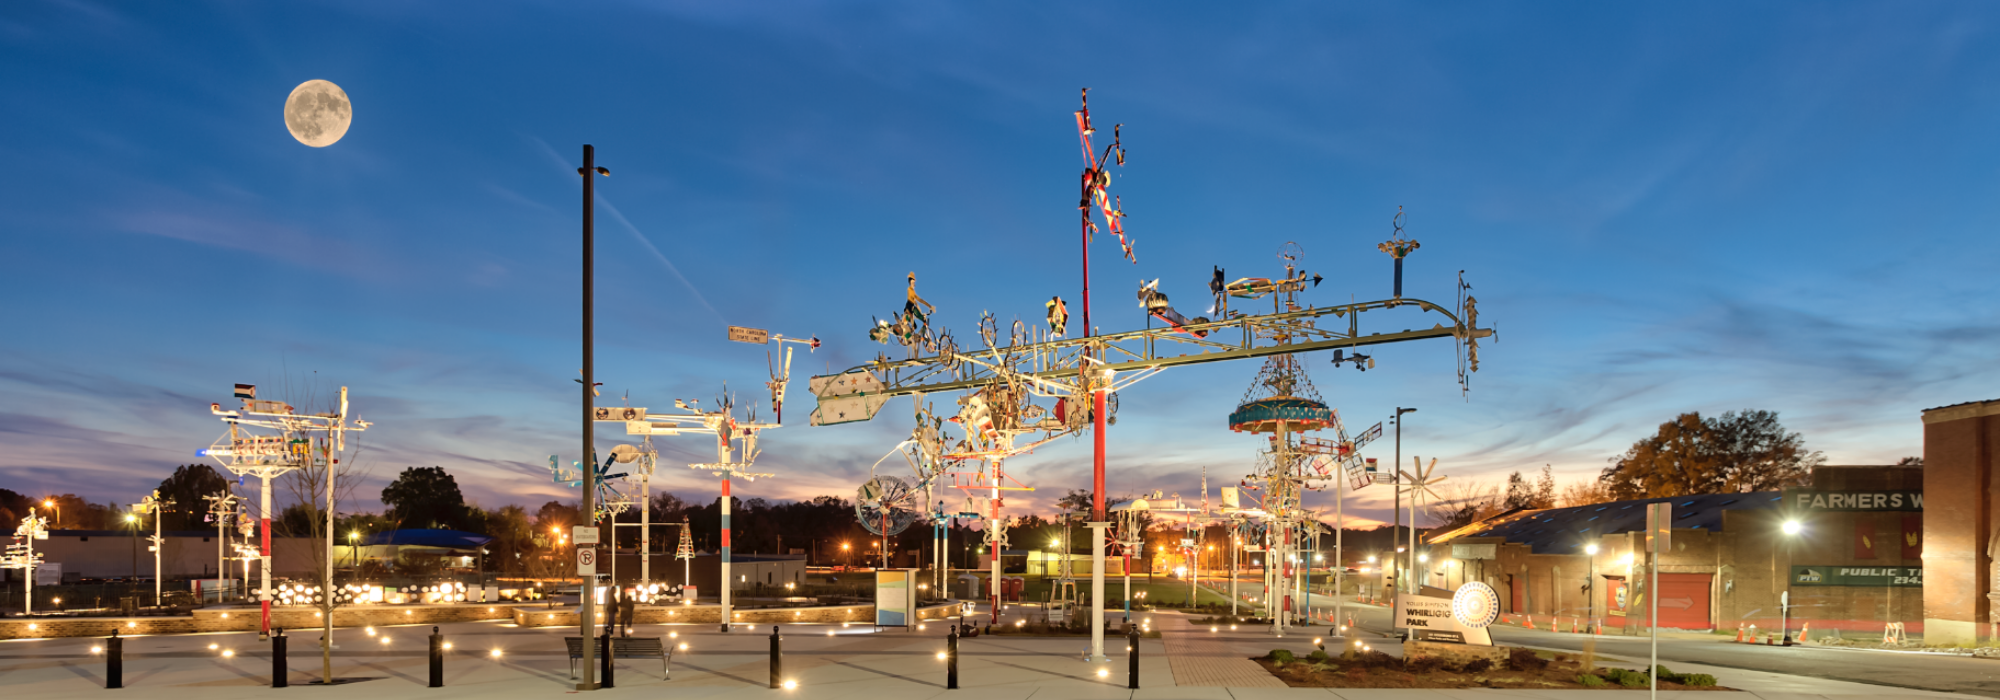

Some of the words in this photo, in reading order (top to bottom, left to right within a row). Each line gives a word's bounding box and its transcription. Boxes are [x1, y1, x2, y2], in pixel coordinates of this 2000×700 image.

[1796, 493, 1903, 509] FARMERS
[1840, 568, 1897, 576] PUBLIC
[1406, 608, 1452, 618] WHIRLIGIG
[1406, 618, 1428, 627] PARK
